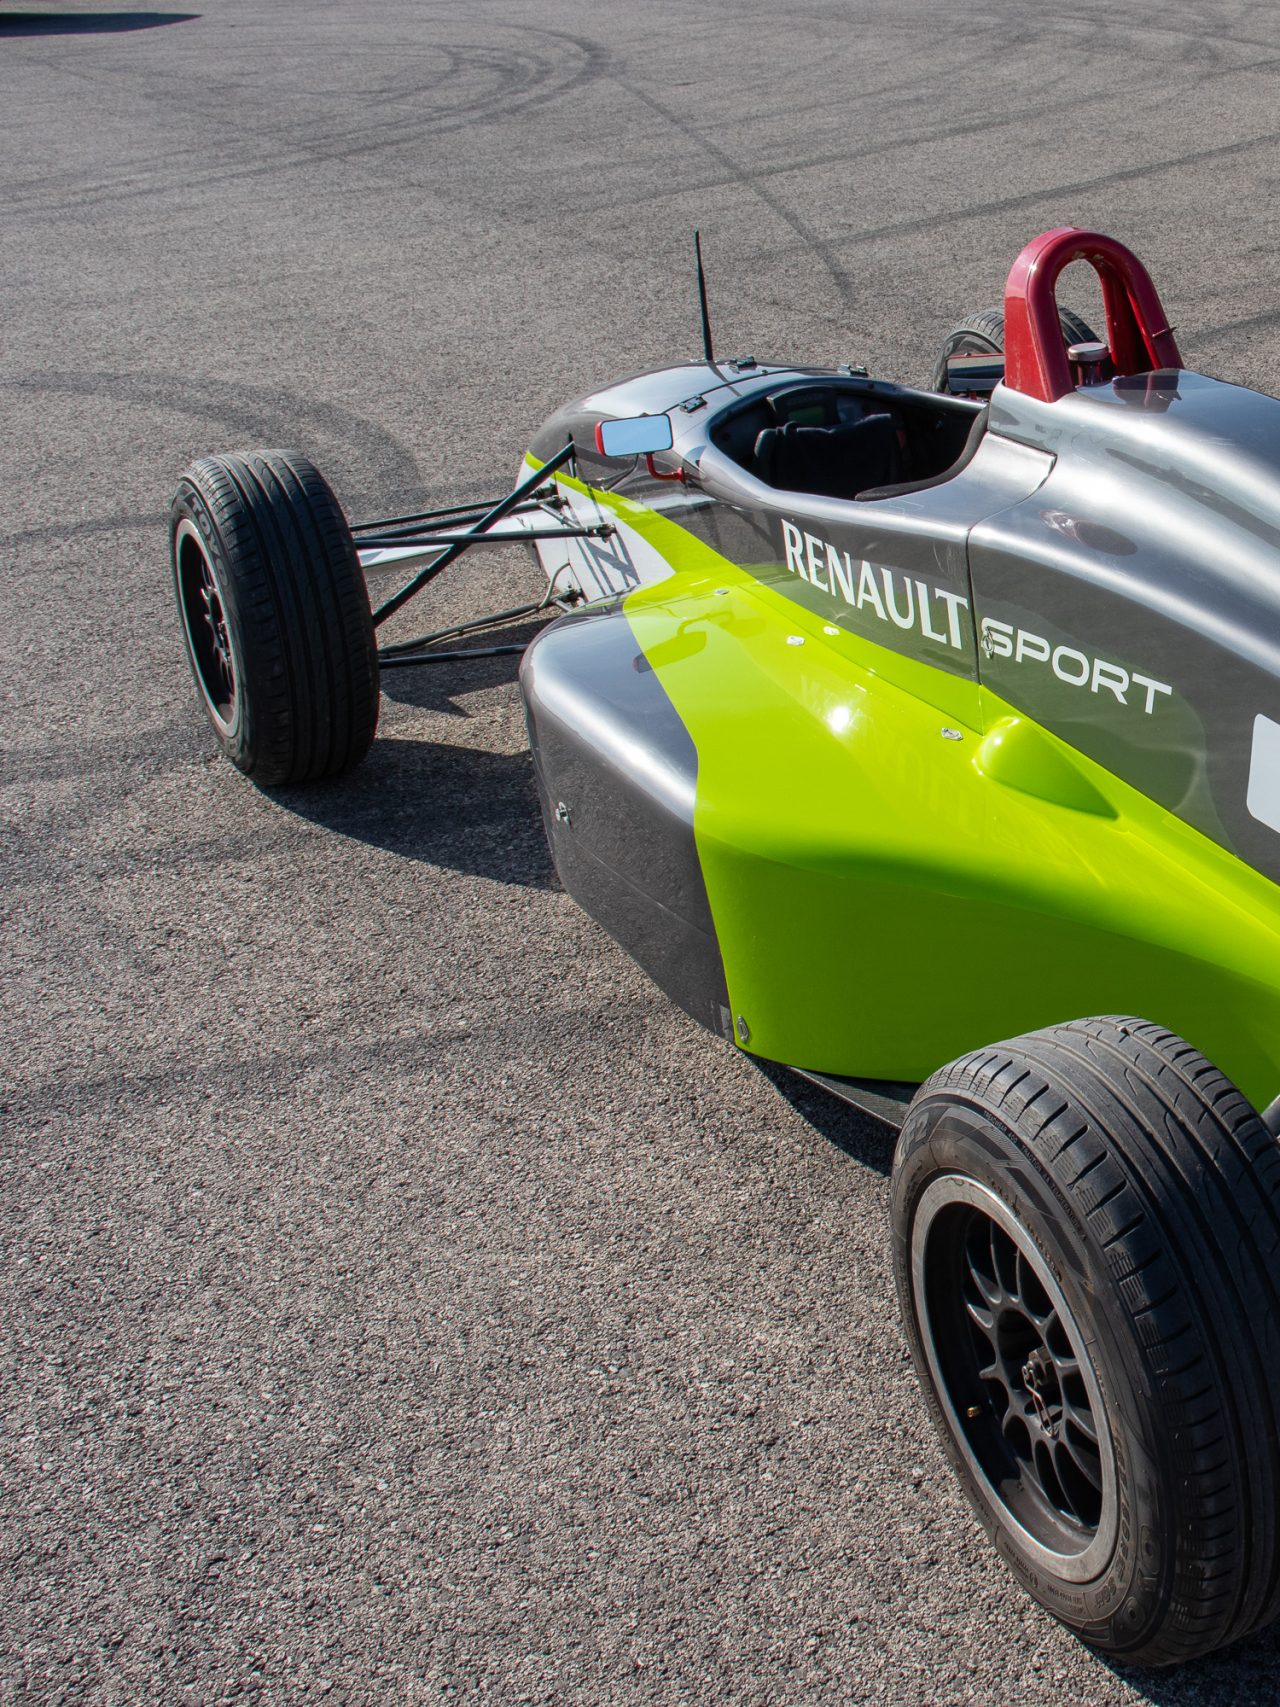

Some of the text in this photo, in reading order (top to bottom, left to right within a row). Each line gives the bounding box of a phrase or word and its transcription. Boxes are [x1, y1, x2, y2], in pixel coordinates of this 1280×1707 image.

[192, 496, 228, 586] TOYO
[780, 518, 1173, 714] RENAULT SPORT
